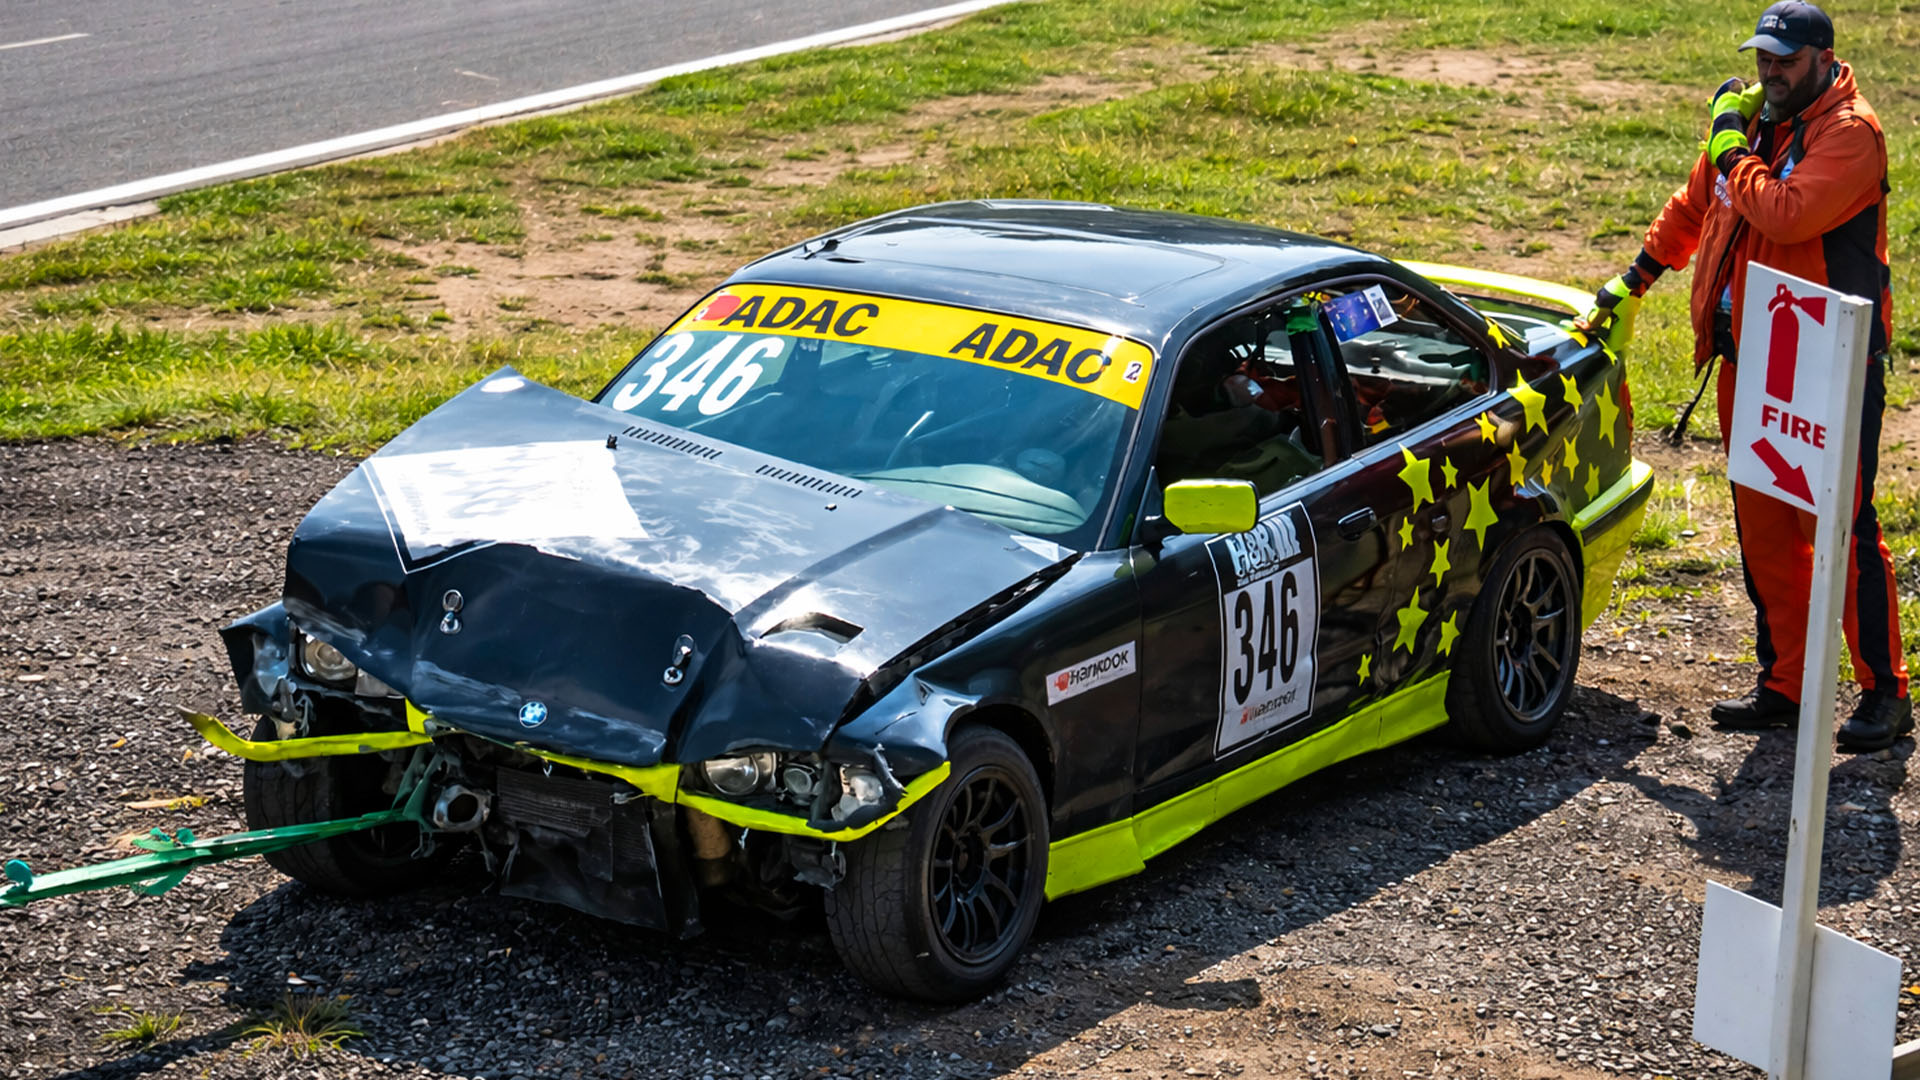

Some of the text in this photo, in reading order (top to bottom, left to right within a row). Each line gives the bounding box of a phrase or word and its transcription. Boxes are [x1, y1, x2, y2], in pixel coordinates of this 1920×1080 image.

[612, 332, 786, 416] 346
[719, 295, 1113, 385] ADAC ADAC
[1126, 362, 1142, 381] 2
[1761, 404, 1827, 450] FIRE
[1233, 570, 1299, 706] 346
